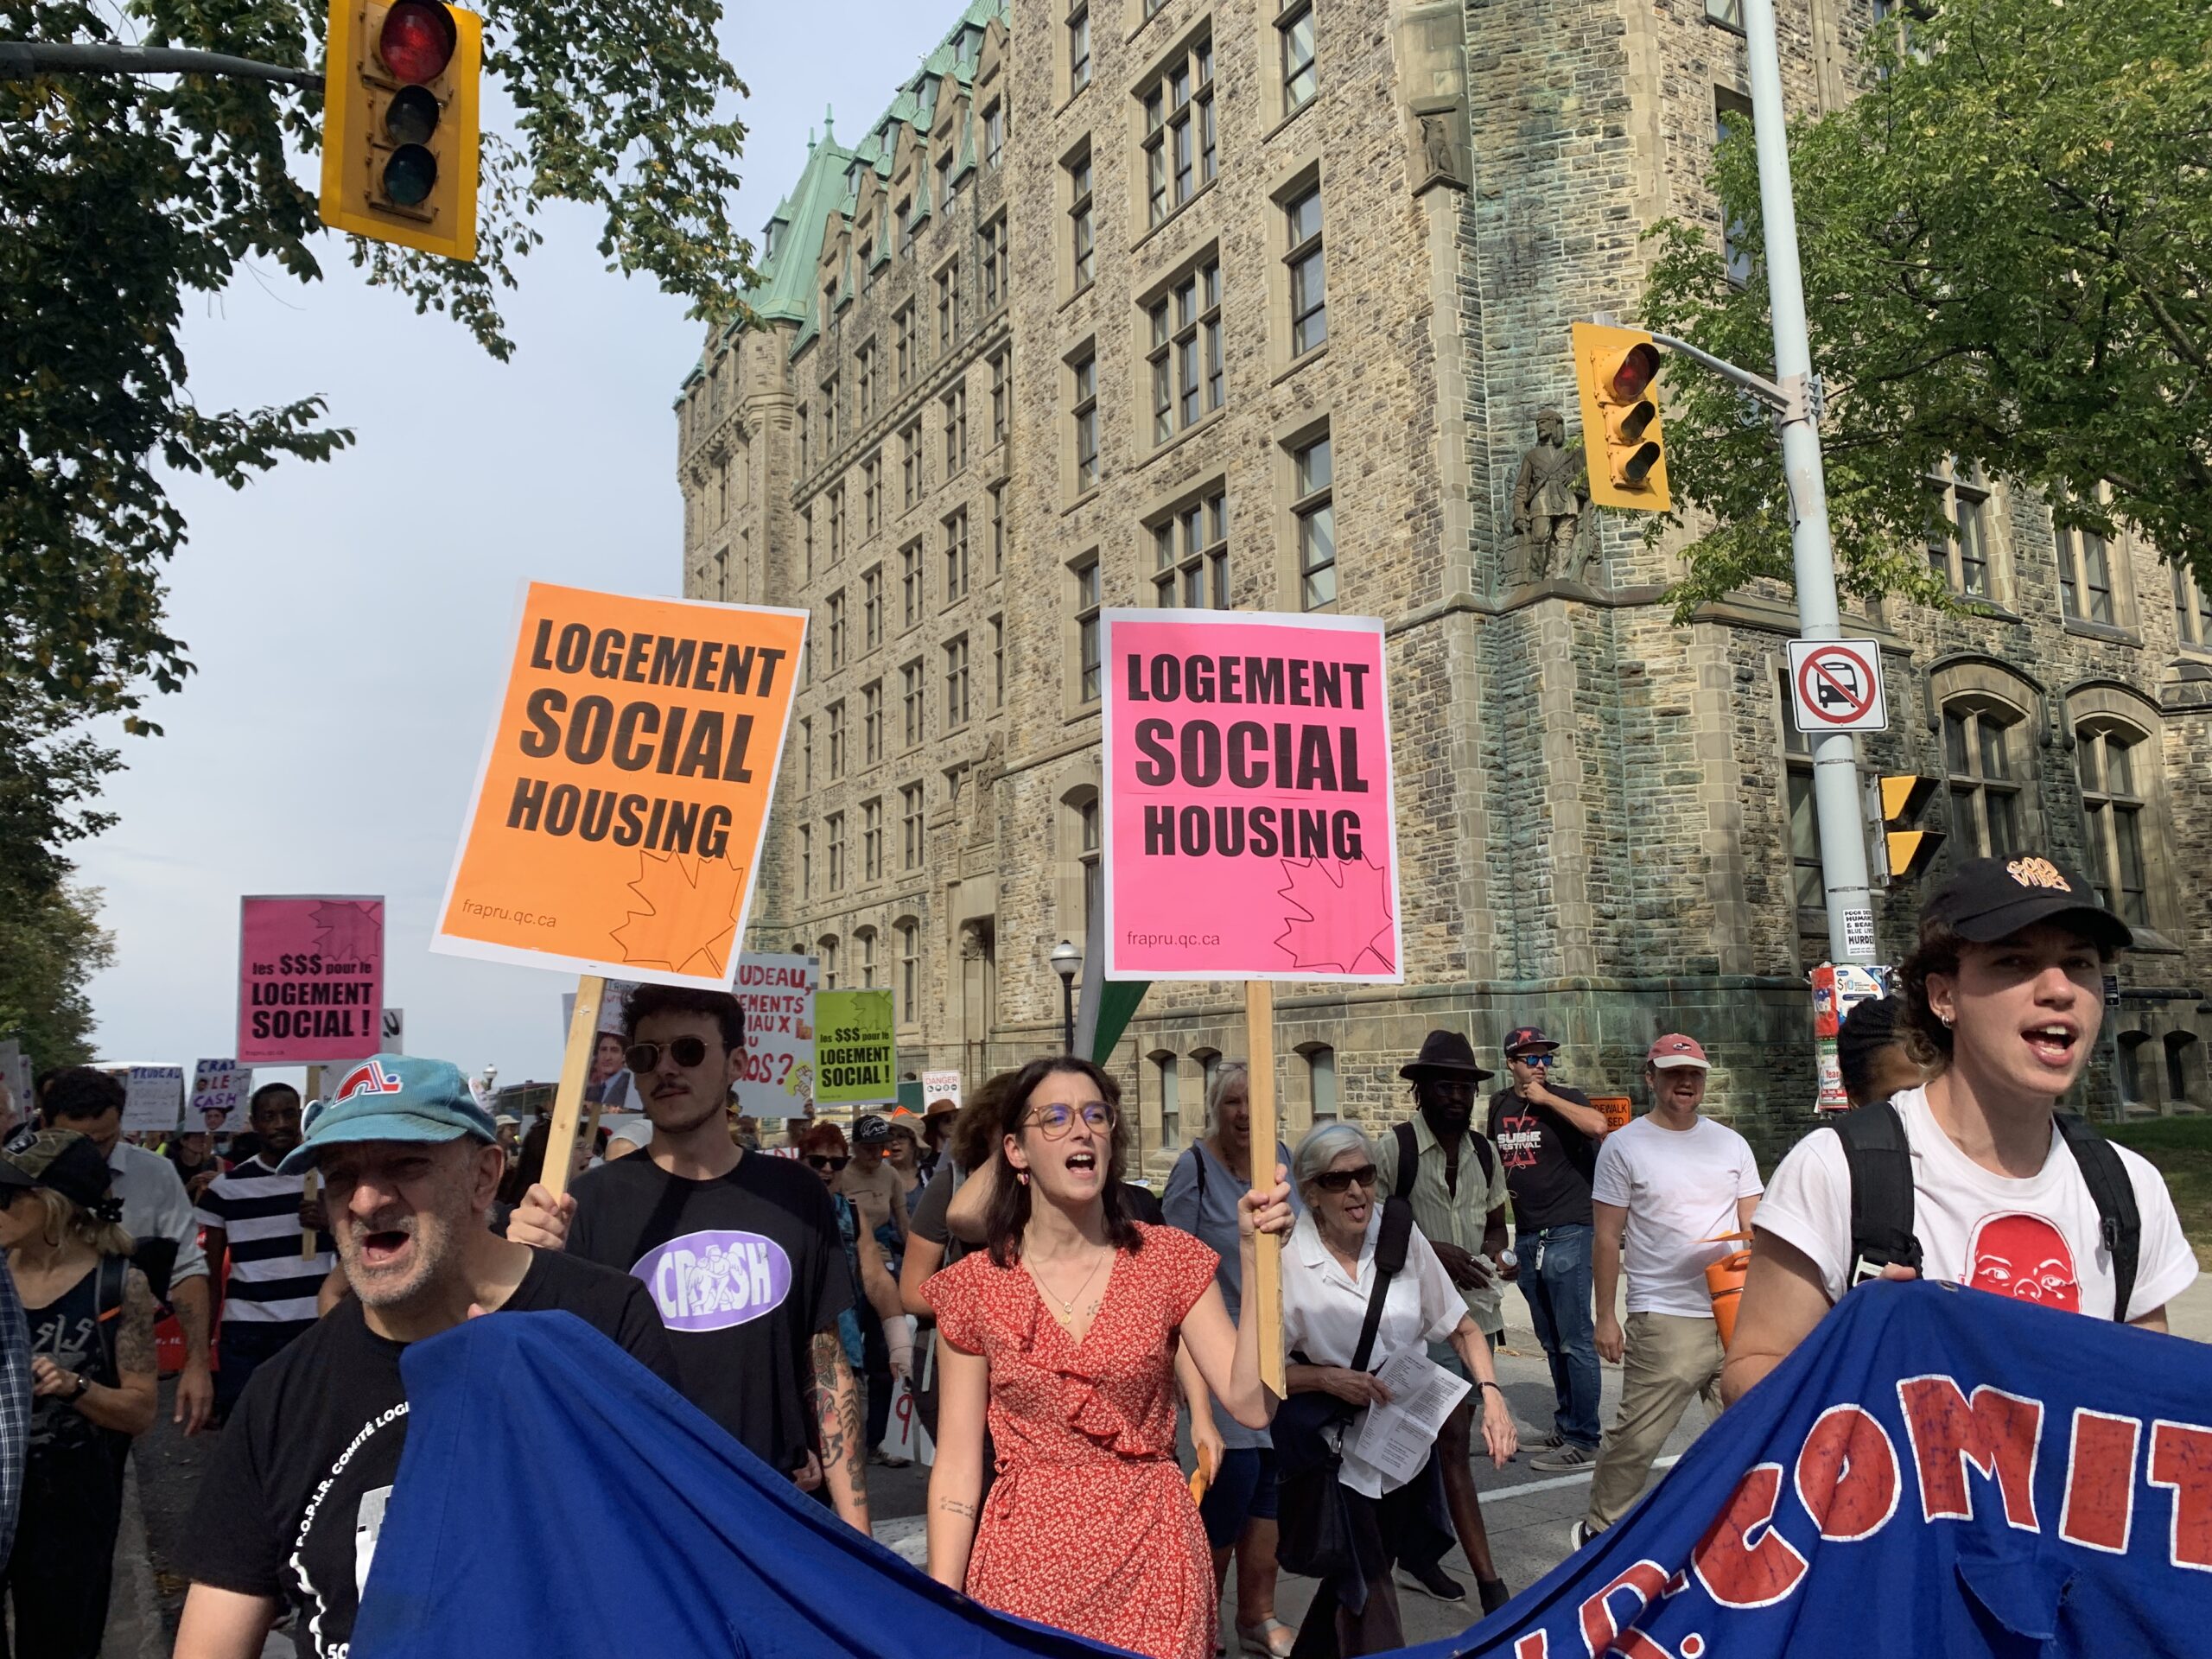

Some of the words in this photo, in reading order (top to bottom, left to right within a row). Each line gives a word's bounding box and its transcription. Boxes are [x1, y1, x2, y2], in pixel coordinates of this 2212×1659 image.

[530, 619, 786, 697] LOGEMENT
[1127, 653, 1369, 710] LOGEMENT
[518, 688, 754, 784] SOCIAL
[1135, 718, 1369, 793] SOCIAL
[505, 777, 733, 859] HOUSING
[1143, 804, 1363, 861] HOUSING
[461, 899, 557, 929] frapru.qc.ca
[1127, 931, 1220, 949] frapru.qc.ca
[1848, 935, 1874, 944] MURDE
[252, 962, 274, 976] les
[279, 952, 322, 976] $$$
[325, 963, 356, 975] pour
[359, 962, 372, 975] le
[735, 964, 812, 995] UDEAU,
[251, 982, 373, 1007] LOGEMENT
[252, 1009, 354, 1039] SOCIAL
[745, 1014, 791, 1033] IAUX
[819, 1033, 832, 1044] les
[835, 1027, 860, 1043] $$$
[861, 1033, 880, 1042] pour
[821, 1046, 890, 1065] LOGEMENT
[822, 1066, 880, 1088] SOCIAL
[194, 1094, 236, 1108] CASH
[1593, 1103, 1627, 1114] DEWALK
[1607, 1117, 1624, 1127] SED
[1499, 1141, 1541, 1150] FESTIVAL
[332, 1421, 375, 1475] COMITÉ
